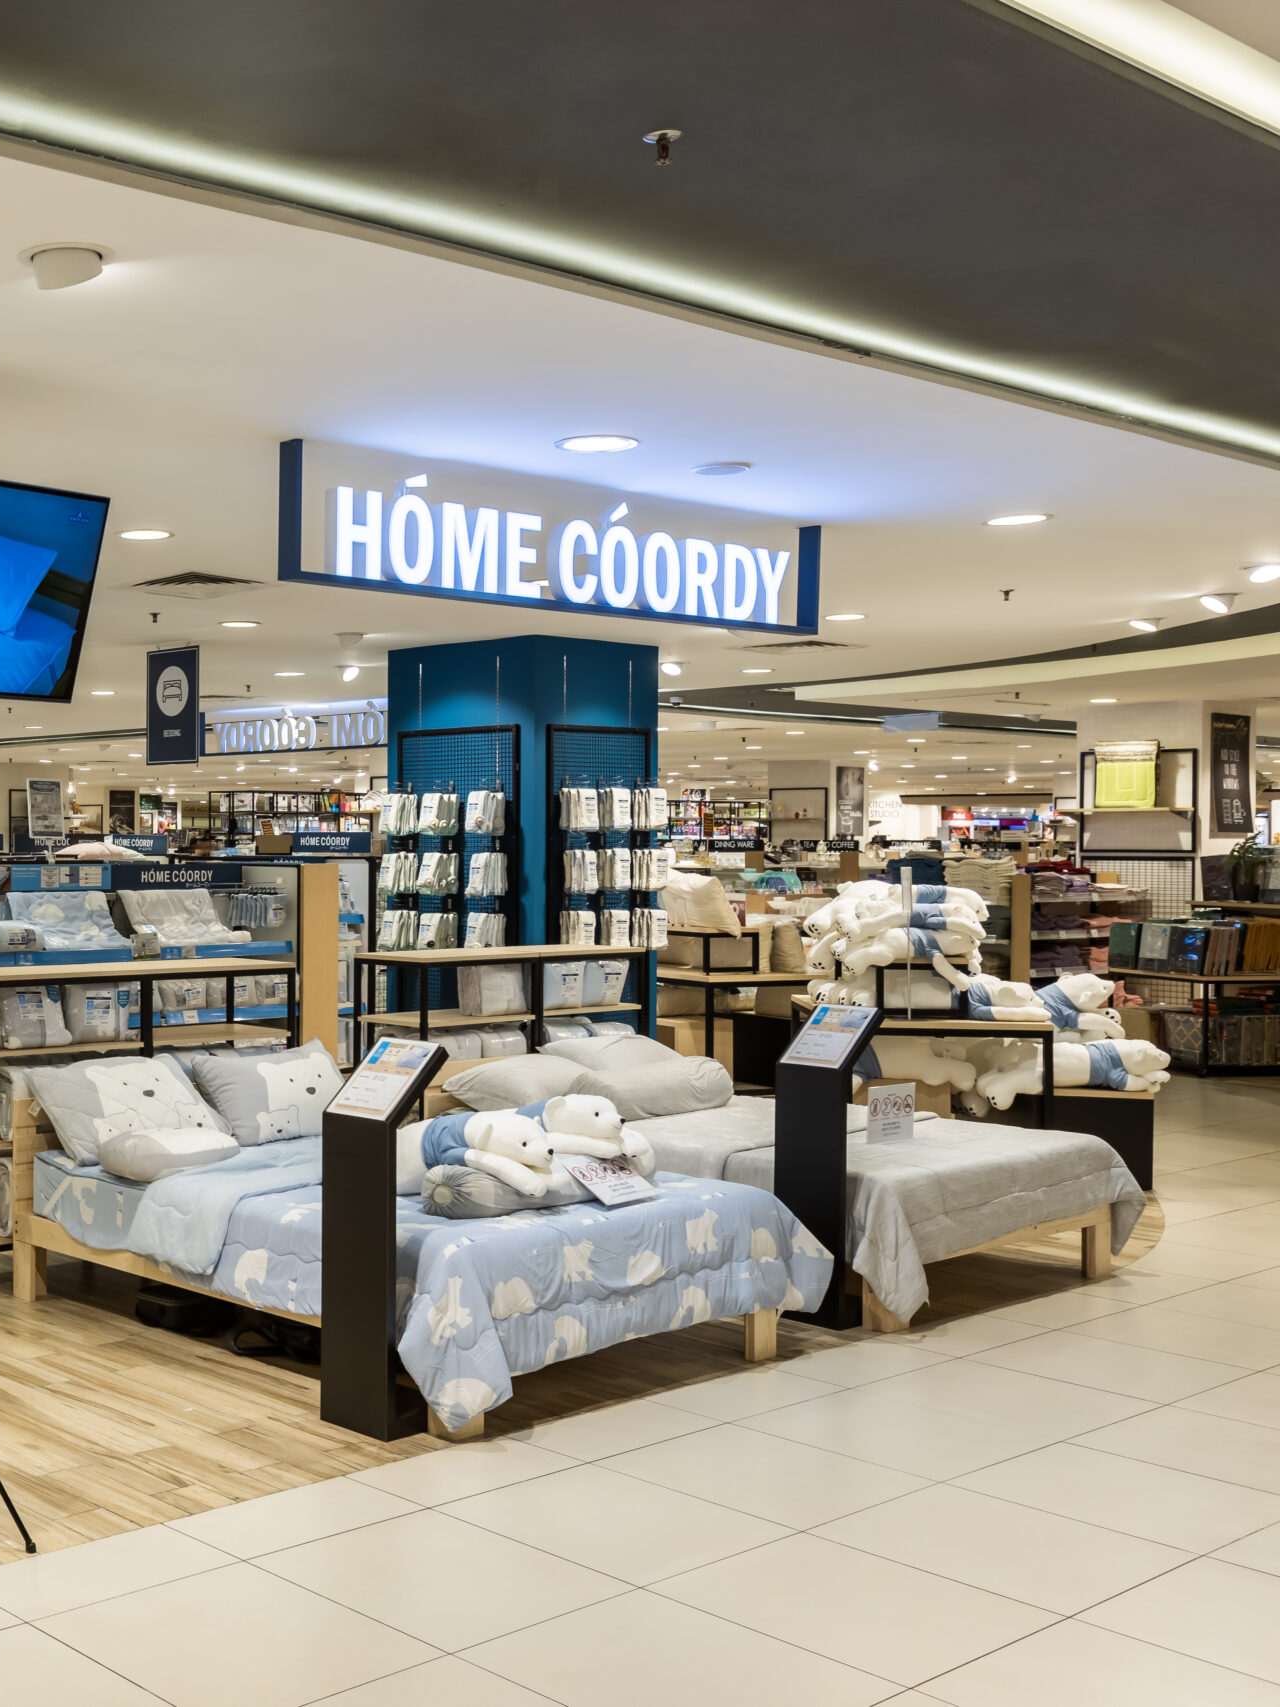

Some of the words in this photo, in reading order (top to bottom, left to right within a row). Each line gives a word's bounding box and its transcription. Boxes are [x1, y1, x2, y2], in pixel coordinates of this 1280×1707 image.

[333, 474, 542, 599] HÓME
[554, 502, 791, 625] CÓORDY
[114, 837, 131, 847] HÓME
[131, 838, 154, 848] CÓORDY
[300, 836, 320, 846] HÓME
[321, 835, 350, 846] CÓORDY
[141, 868, 170, 883] HÓME
[172, 867, 213, 882] CÓORDY
